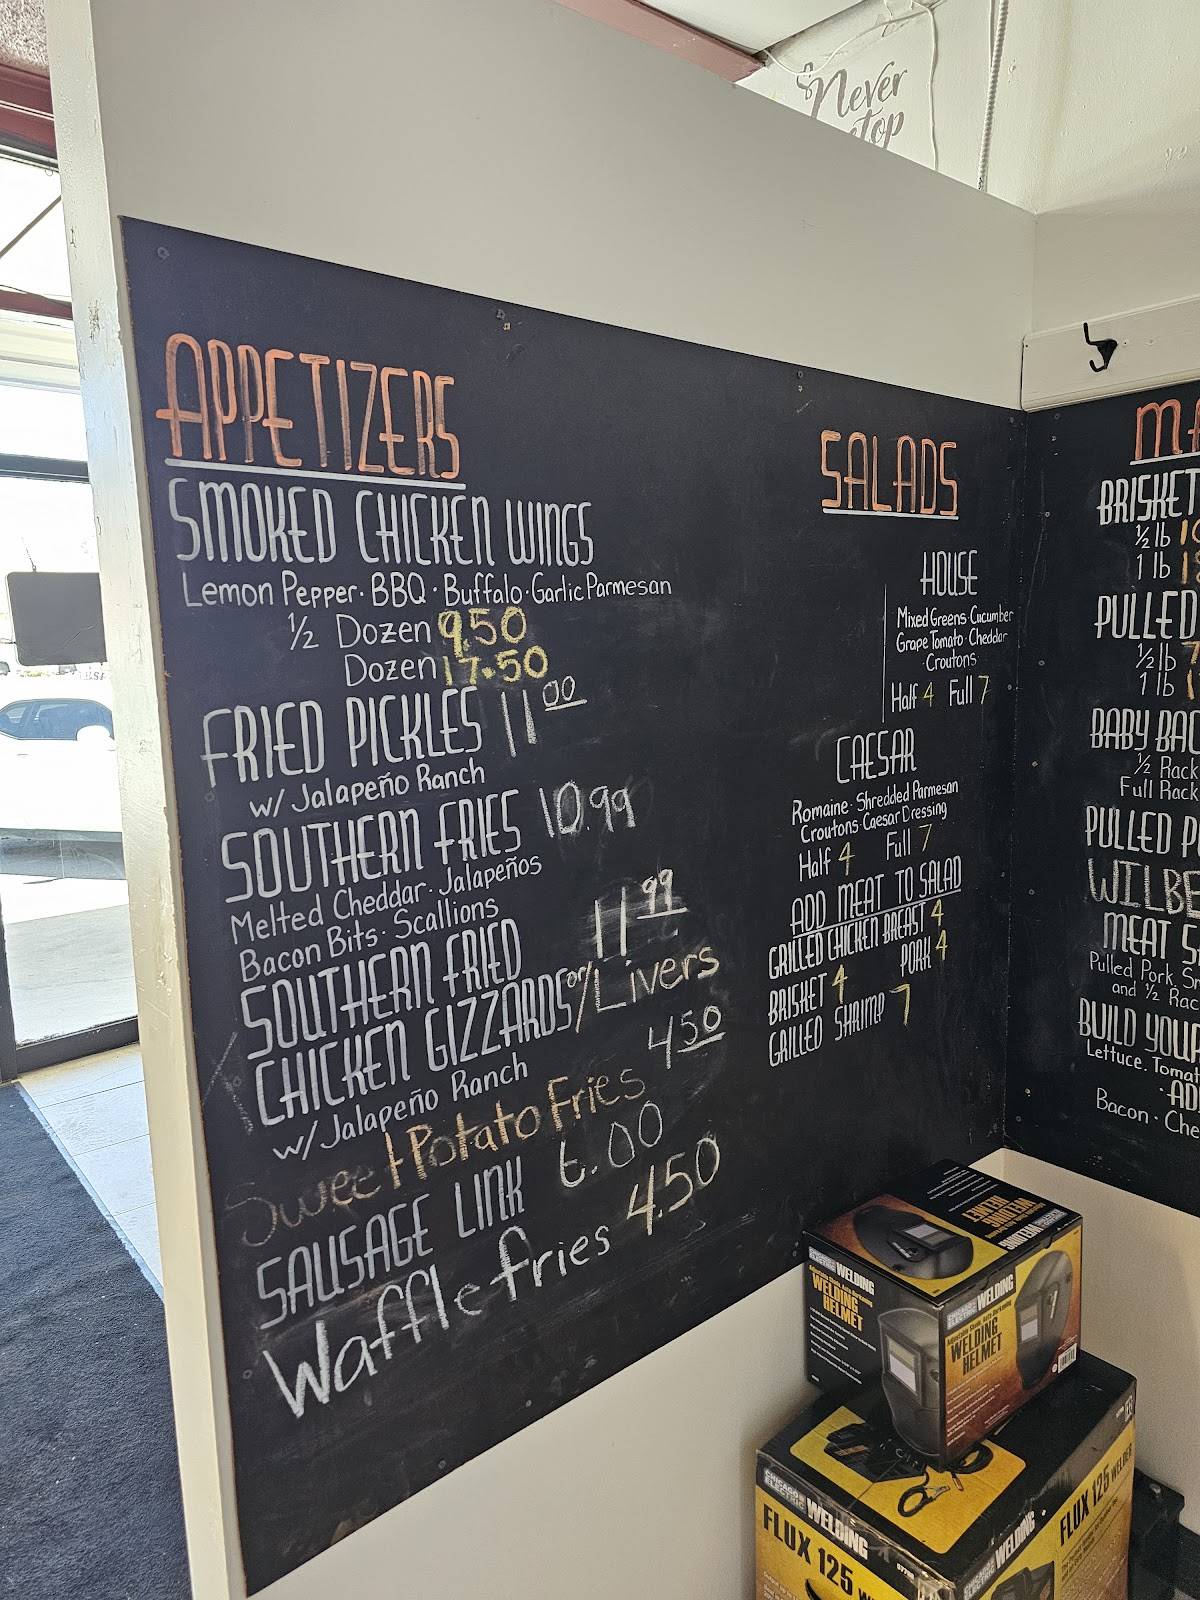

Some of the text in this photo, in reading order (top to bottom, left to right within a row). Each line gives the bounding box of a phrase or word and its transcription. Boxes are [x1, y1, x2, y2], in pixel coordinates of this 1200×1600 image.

[797, 61, 907, 119] Never
[155, 333, 460, 478] APPETIZERS
[820, 429, 958, 516] SALADS
[1096, 467, 1200, 526] BRISKET
[168, 477, 594, 567] SMOKED CHICKEN WINGS
[1155, 521, 1171, 548] lb
[182, 571, 274, 608] Lemon
[371, 571, 426, 608] BBQ
[443, 571, 523, 607] Buffalo
[531, 571, 584, 605] Garlic
[586, 571, 672, 601] Parmesan
[920, 549, 978, 596] HOUSE
[1153, 550, 1171, 580] lb
[336, 613, 432, 649] Dozen
[896, 603, 1015, 628] Mixed Greens Cucumber
[1094, 589, 1198, 640] PULLED
[896, 627, 1009, 653] Grape Tomato Cheddar
[926, 651, 977, 672] Croutons
[1159, 642, 1177, 671] lb
[344, 645, 548, 687] Dozen 17.50
[1156, 671, 1175, 697] lb
[891, 675, 990, 713] Half 4 Full 7
[200, 700, 325, 788] FRIED
[345, 685, 483, 768] PICKLES
[1090, 707, 1150, 750] BABY
[835, 727, 918, 784] CAESAR
[1160, 755, 1199, 780] Rack
[249, 757, 485, 818] w/ Jalapeño Ranch
[791, 779, 959, 826] Romaine Shredded Parmesan
[1120, 775, 1199, 801] Full Rack
[221, 780, 637, 904] SOUTHERN FRIES 10.99
[800, 801, 948, 845] Croutons Caesar Dressing
[1085, 805, 1172, 854] PULLED
[799, 823, 933, 882] Half 4 Full 7
[230, 855, 542, 945] Melted Cheddar Jalapeños
[790, 855, 961, 936] ADD MEAT TO SALAD
[239, 897, 499, 983] Bacon Bits Scallions
[768, 899, 945, 980] GRILLED CHICKEN BREAST 4
[1103, 912, 1172, 960] MEAT
[240, 918, 522, 1060] SOUTHERN FRIED
[767, 929, 949, 1027] BRISKET 4 PORK 4
[1090, 951, 1133, 979] Pulled
[1112, 980, 1136, 997] and
[255, 1020, 411, 1126] CHICKEN
[424, 967, 572, 1072] GIZZARDS
[768, 983, 911, 1069] GRILLED SHRIMP 7
[1077, 997, 1137, 1047] BUILD
[272, 1052, 529, 1161] w/ Jalapeño Ranch
[405, 1100, 540, 1181] Potato
[547, 1068, 646, 1132] Fries
[1096, 1087, 1149, 1125] Bacon
[256, 1192, 434, 1330] SAUSAGE
[455, 1155, 525, 1239] LINK
[262, 1264, 482, 1420] Waffle
[625, 1135, 720, 1237] 4.50
[812, 1272, 859, 1314] WELDING
[836, 1261, 875, 1296] WELDING
[977, 1273, 1014, 1310] WELDING
[823, 1294, 863, 1331] HELMET
[950, 1315, 998, 1363] WELDING
[962, 1332, 1002, 1376] HELMET
[806, 1497, 869, 1560] WELDING
[1060, 1488, 1090, 1547] FLUX
[1092, 1463, 1109, 1507] 125
[763, 1503, 811, 1565] FLUX
[818, 1547, 853, 1596] 125
[995, 1510, 1035, 1570] WELDING
